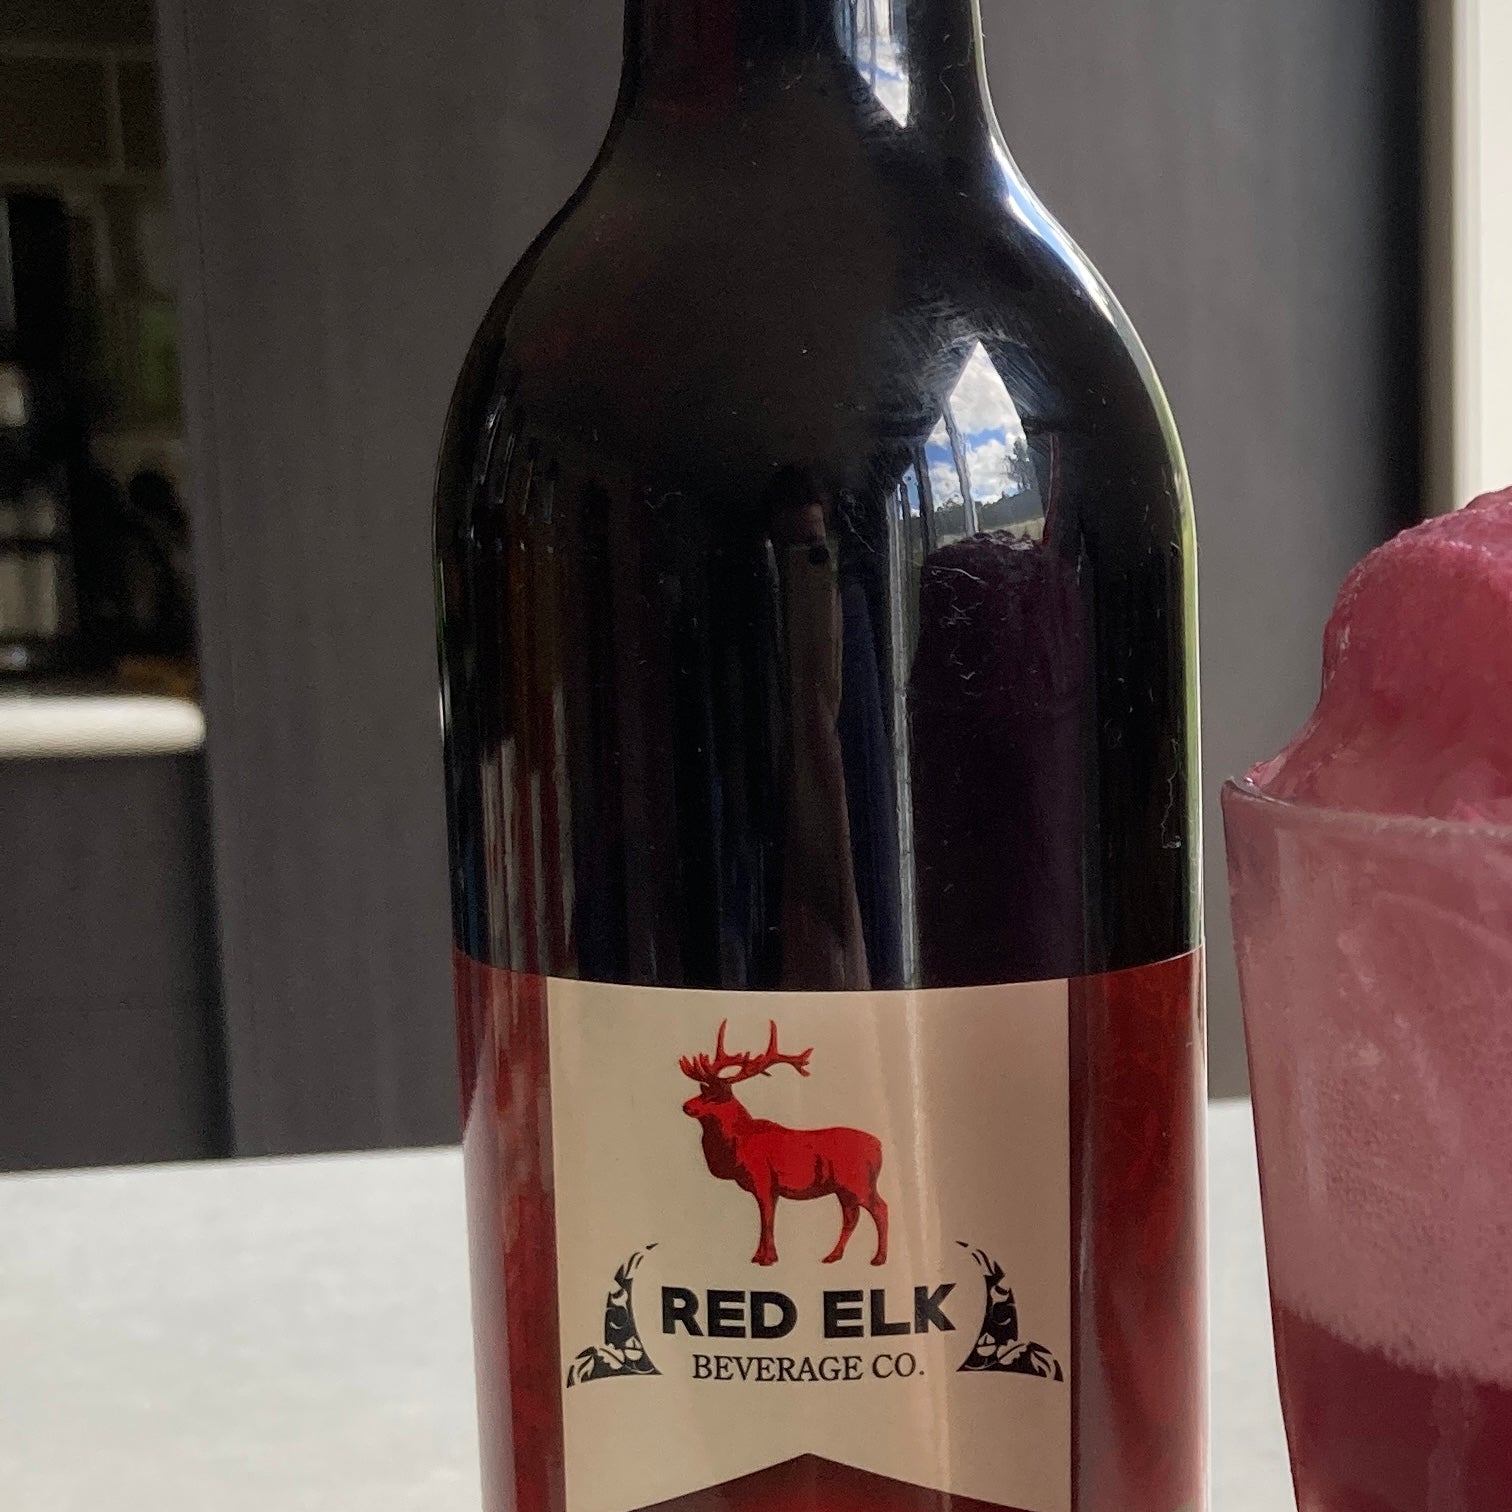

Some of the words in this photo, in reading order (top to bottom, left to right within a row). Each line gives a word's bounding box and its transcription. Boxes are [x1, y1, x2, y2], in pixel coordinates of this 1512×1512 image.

[661, 1285, 798, 1339] RED
[822, 1282, 957, 1338] ELK
[692, 1354, 864, 1383] BEVERAGE
[872, 1352, 926, 1380] CO.
